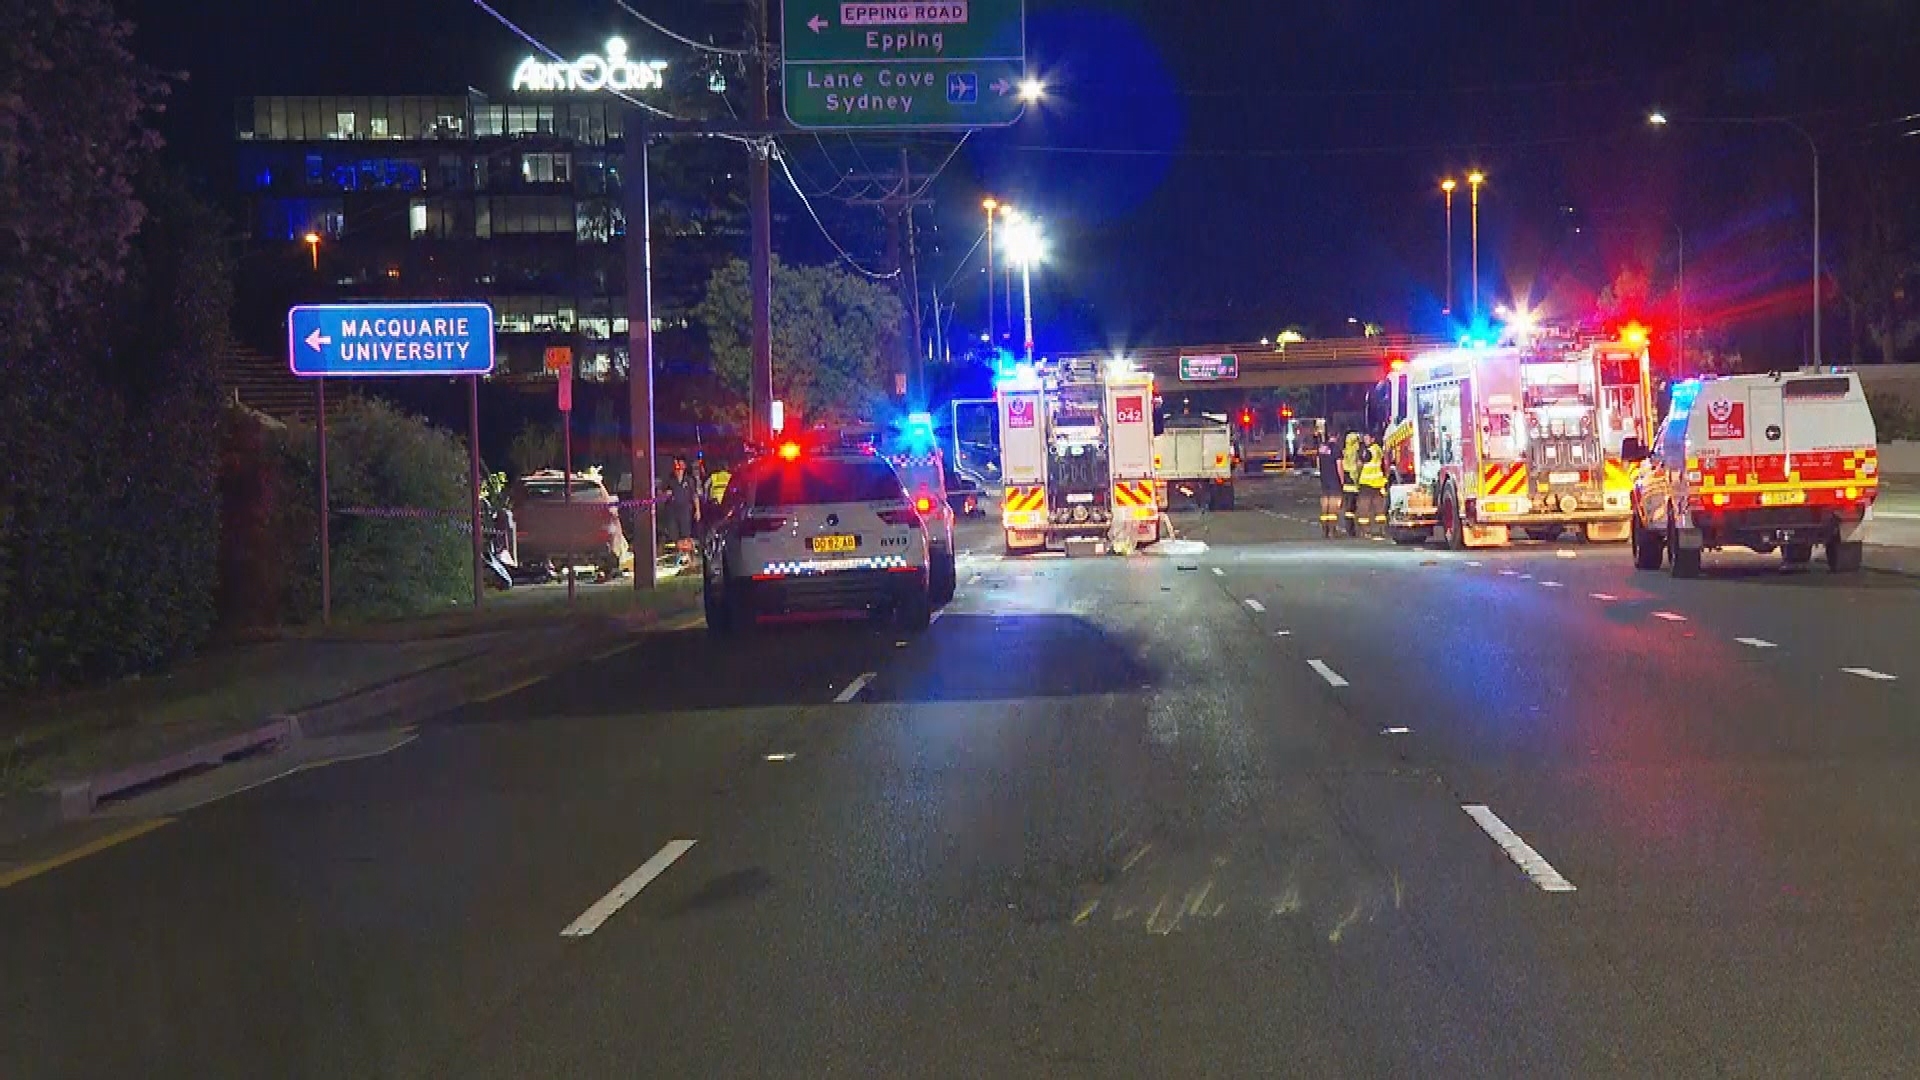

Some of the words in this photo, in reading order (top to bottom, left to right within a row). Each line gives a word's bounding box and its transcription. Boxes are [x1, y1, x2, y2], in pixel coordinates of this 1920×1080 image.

[844, 6, 908, 21] EPPING
[915, 5, 963, 20] ROAD
[866, 31, 944, 52] Epping
[512, 37, 668, 91] ARISTOCRAT
[807, 71, 864, 89] Lane
[878, 69, 936, 87] Cove
[826, 93, 913, 114] Sydney
[341, 318, 470, 337] MACQUARIE
[340, 341, 470, 361] UNIVERSITY
